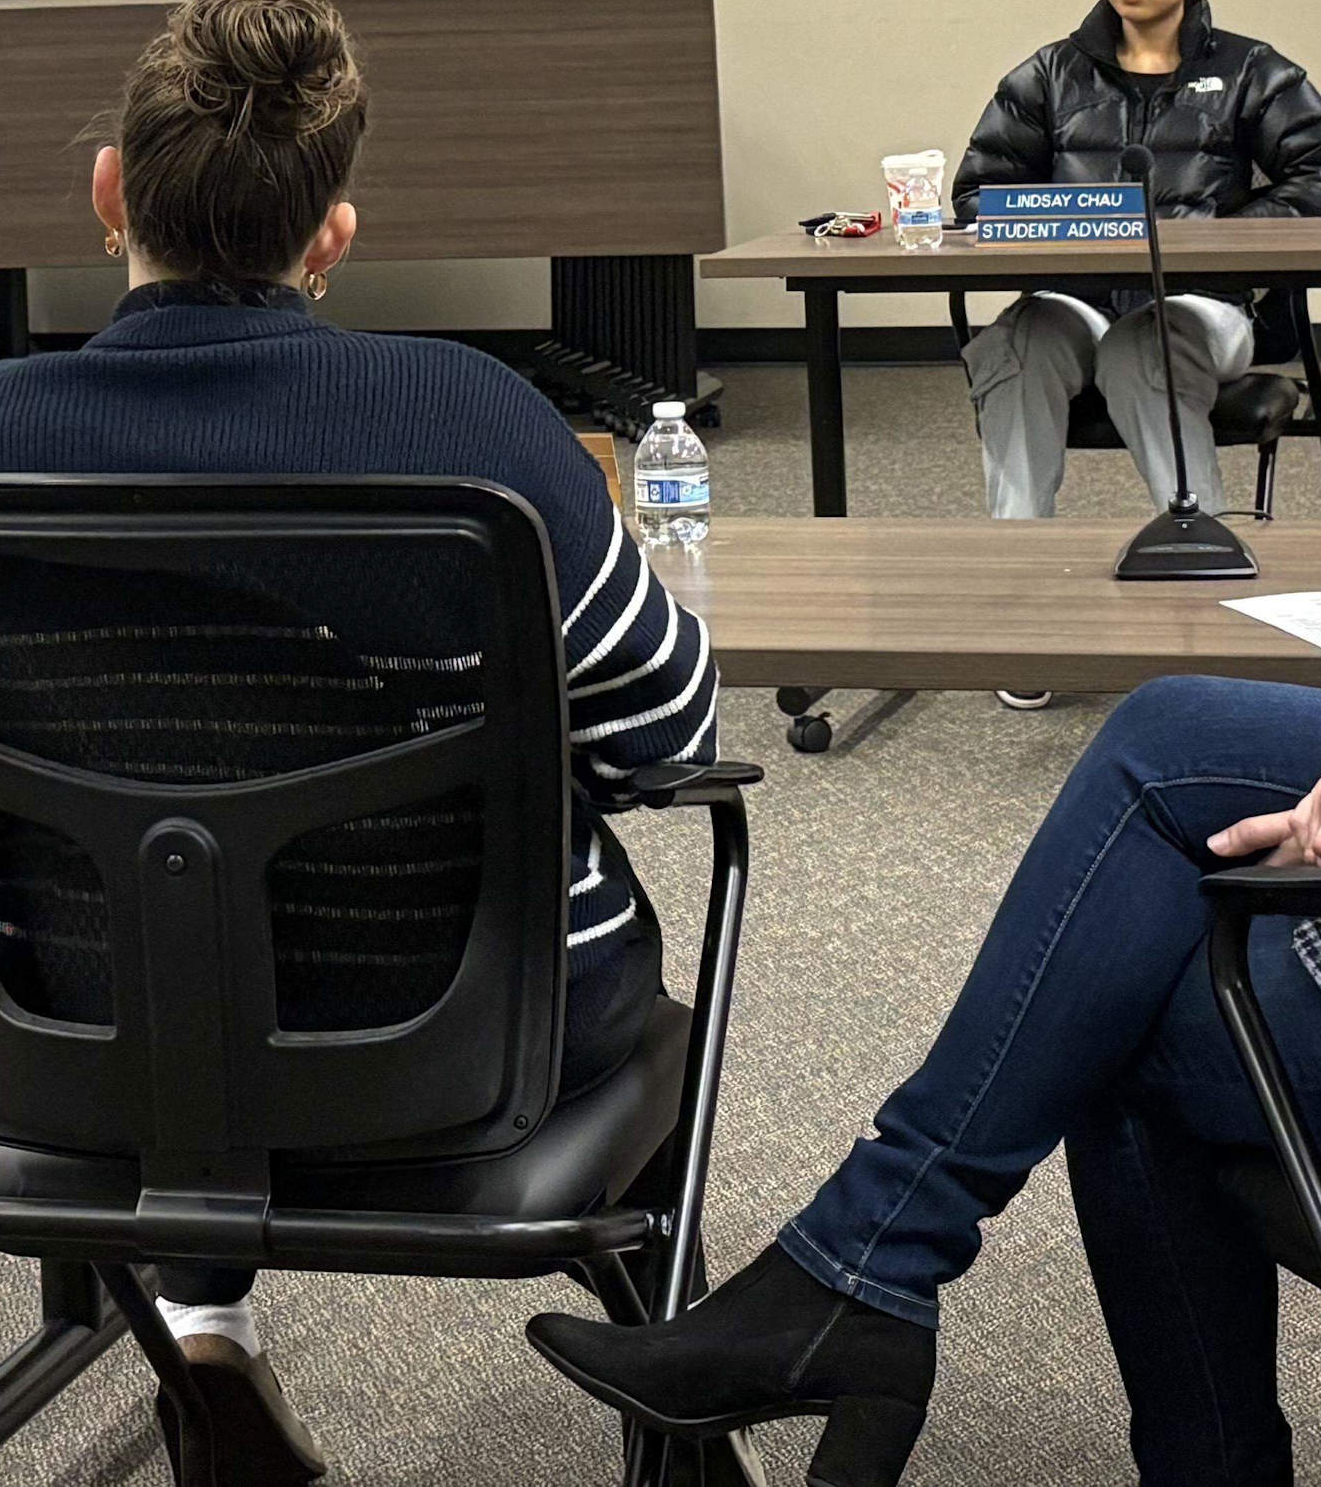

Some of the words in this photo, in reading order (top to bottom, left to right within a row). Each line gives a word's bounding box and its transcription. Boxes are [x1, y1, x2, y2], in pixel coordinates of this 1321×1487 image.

[1005, 194, 1071, 208] LINDSAY
[1078, 193, 1122, 207] CHAU
[982, 222, 1061, 239] STUDENT
[1067, 221, 1144, 237] ADVISOR
